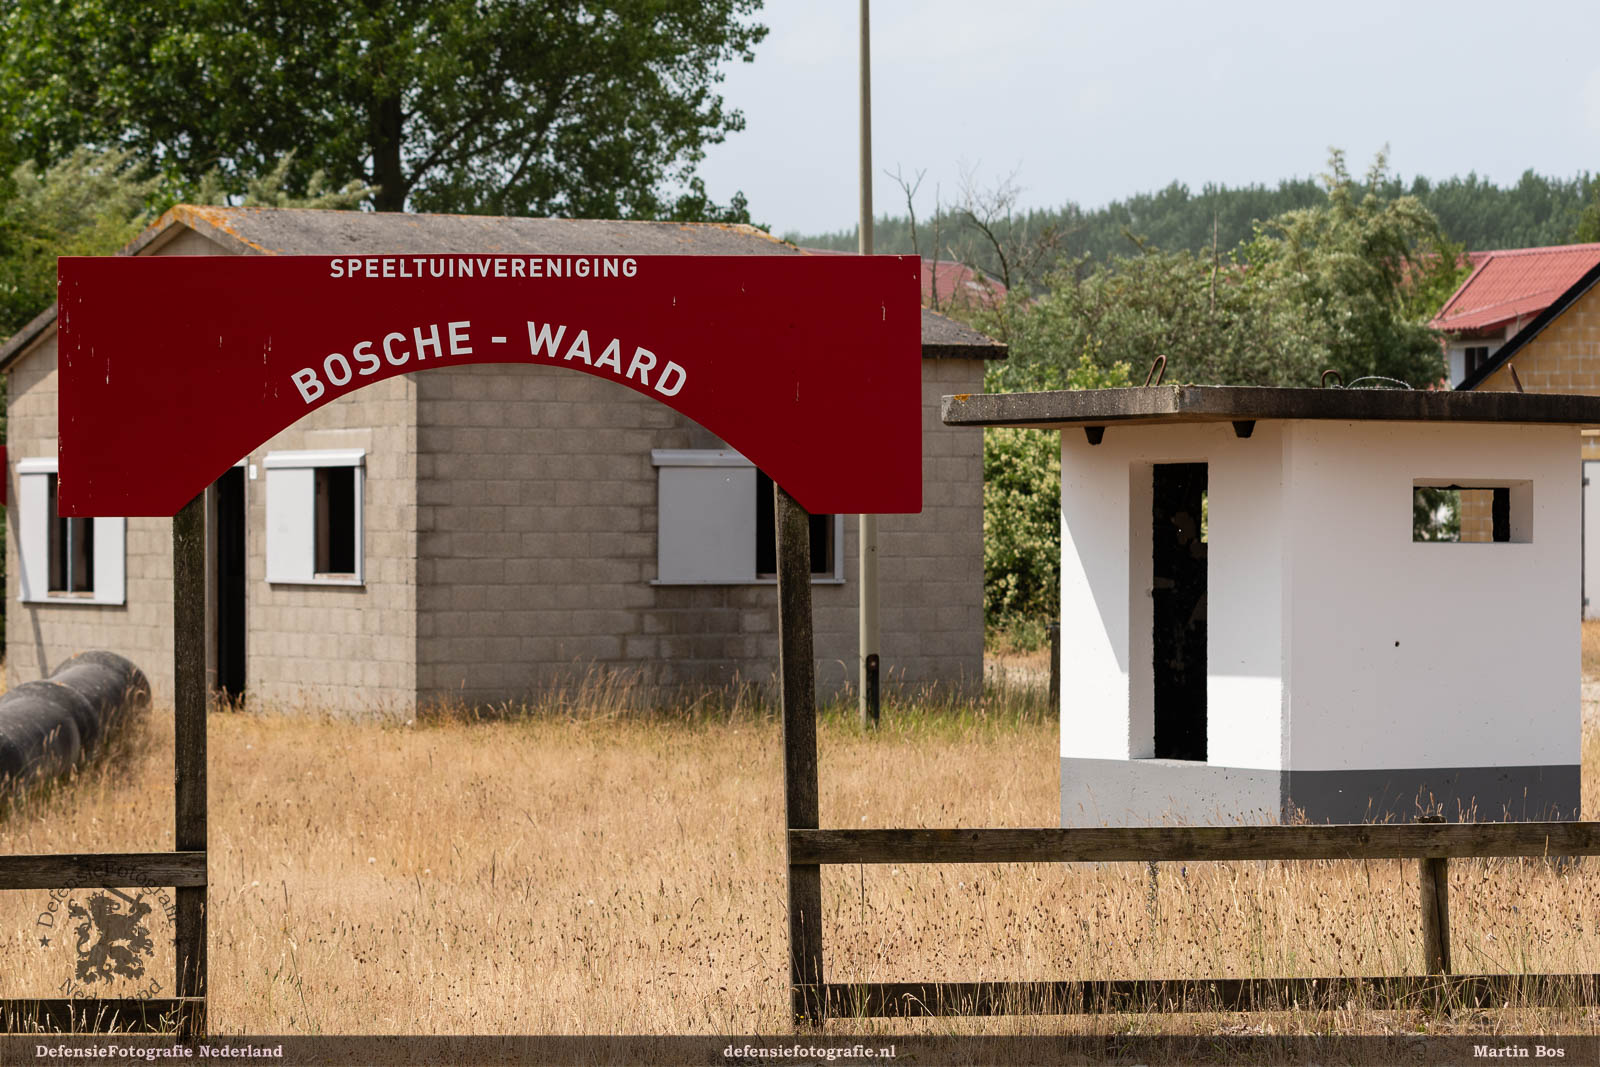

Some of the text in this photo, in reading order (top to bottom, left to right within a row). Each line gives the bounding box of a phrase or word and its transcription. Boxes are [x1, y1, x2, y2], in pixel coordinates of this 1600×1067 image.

[330, 258, 637, 278] SPEELTUINVERENIGING
[290, 320, 473, 405] BOSCHE
[527, 320, 687, 397] WAARD
